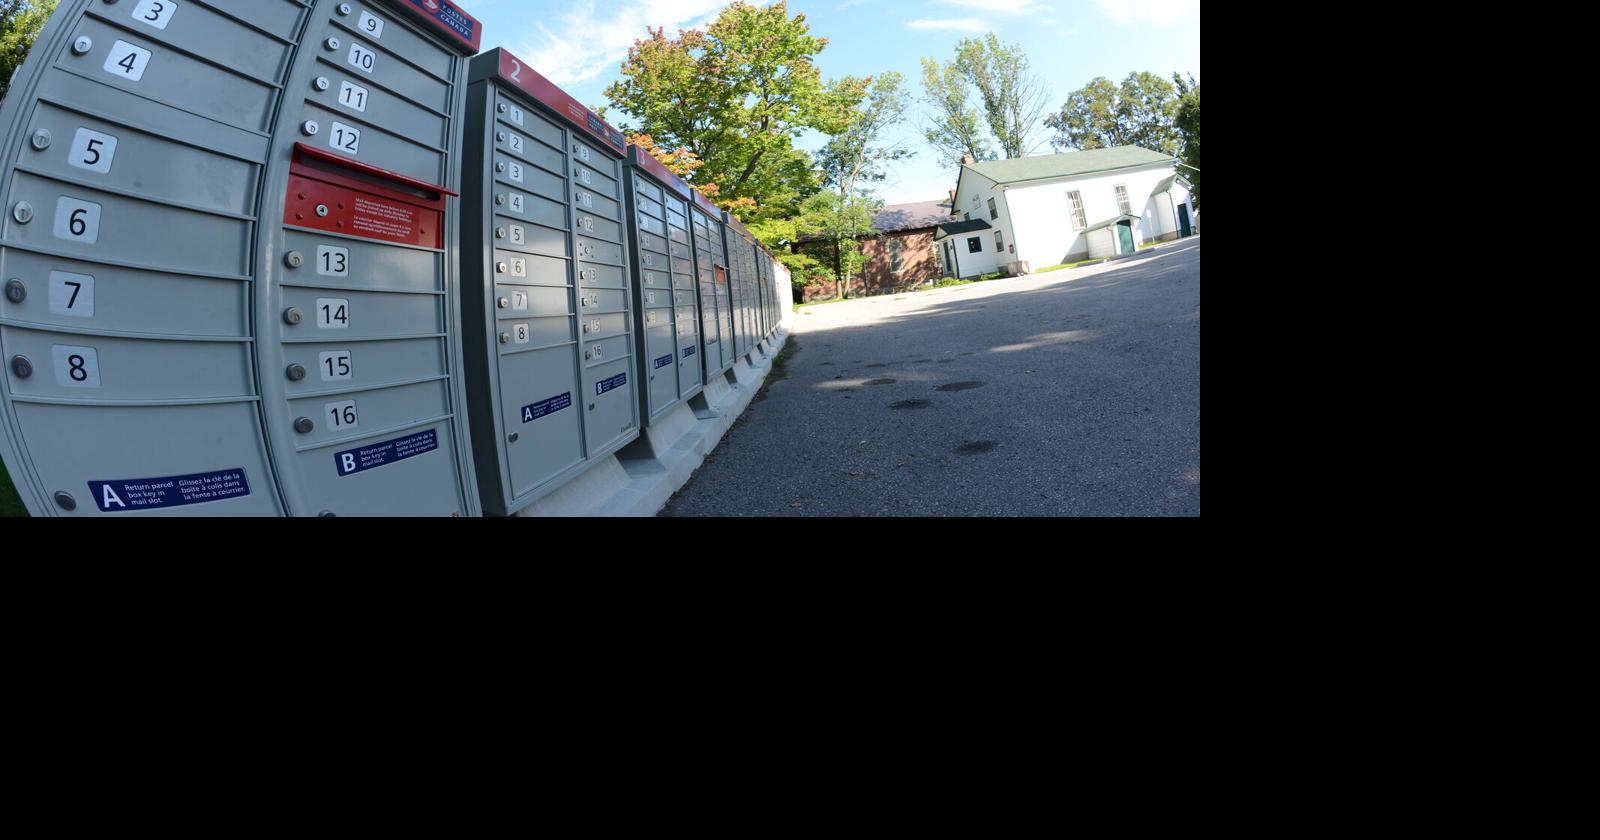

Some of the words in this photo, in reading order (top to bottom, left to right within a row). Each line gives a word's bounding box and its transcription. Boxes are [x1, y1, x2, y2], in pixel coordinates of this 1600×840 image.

[144, 2, 164, 21] 3
[366, 18, 376, 32] 9
[440, 14, 468, 36] CANADA
[118, 52, 137, 74] 4
[354, 49, 373, 69] 10
[510, 58, 521, 84] 2
[345, 87, 363, 108] 11
[515, 110, 519, 121] 1
[336, 129, 357, 151] 12
[513, 136, 520, 150] 2
[83, 138, 104, 165] 5
[513, 166, 519, 178] 3
[513, 196, 520, 208] 4
[69, 208, 88, 236] 6
[586, 220, 592, 230] 12
[514, 228, 520, 241] 5
[322, 251, 346, 273] 13
[515, 260, 521, 273] 6
[589, 270, 596, 280] 13
[64, 280, 81, 309] 7
[516, 294, 522, 306] 7
[590, 295, 598, 305] 14
[322, 304, 347, 325] 14
[518, 326, 525, 340] 8
[593, 346, 601, 356] 16
[68, 354, 88, 382] 8
[324, 356, 350, 377] 15
[597, 382, 602, 394] B
[330, 405, 356, 426] 16
[525, 407, 533, 422] A
[341, 452, 356, 472] B
[151, 481, 174, 490] parcel
[102, 484, 126, 508] A
